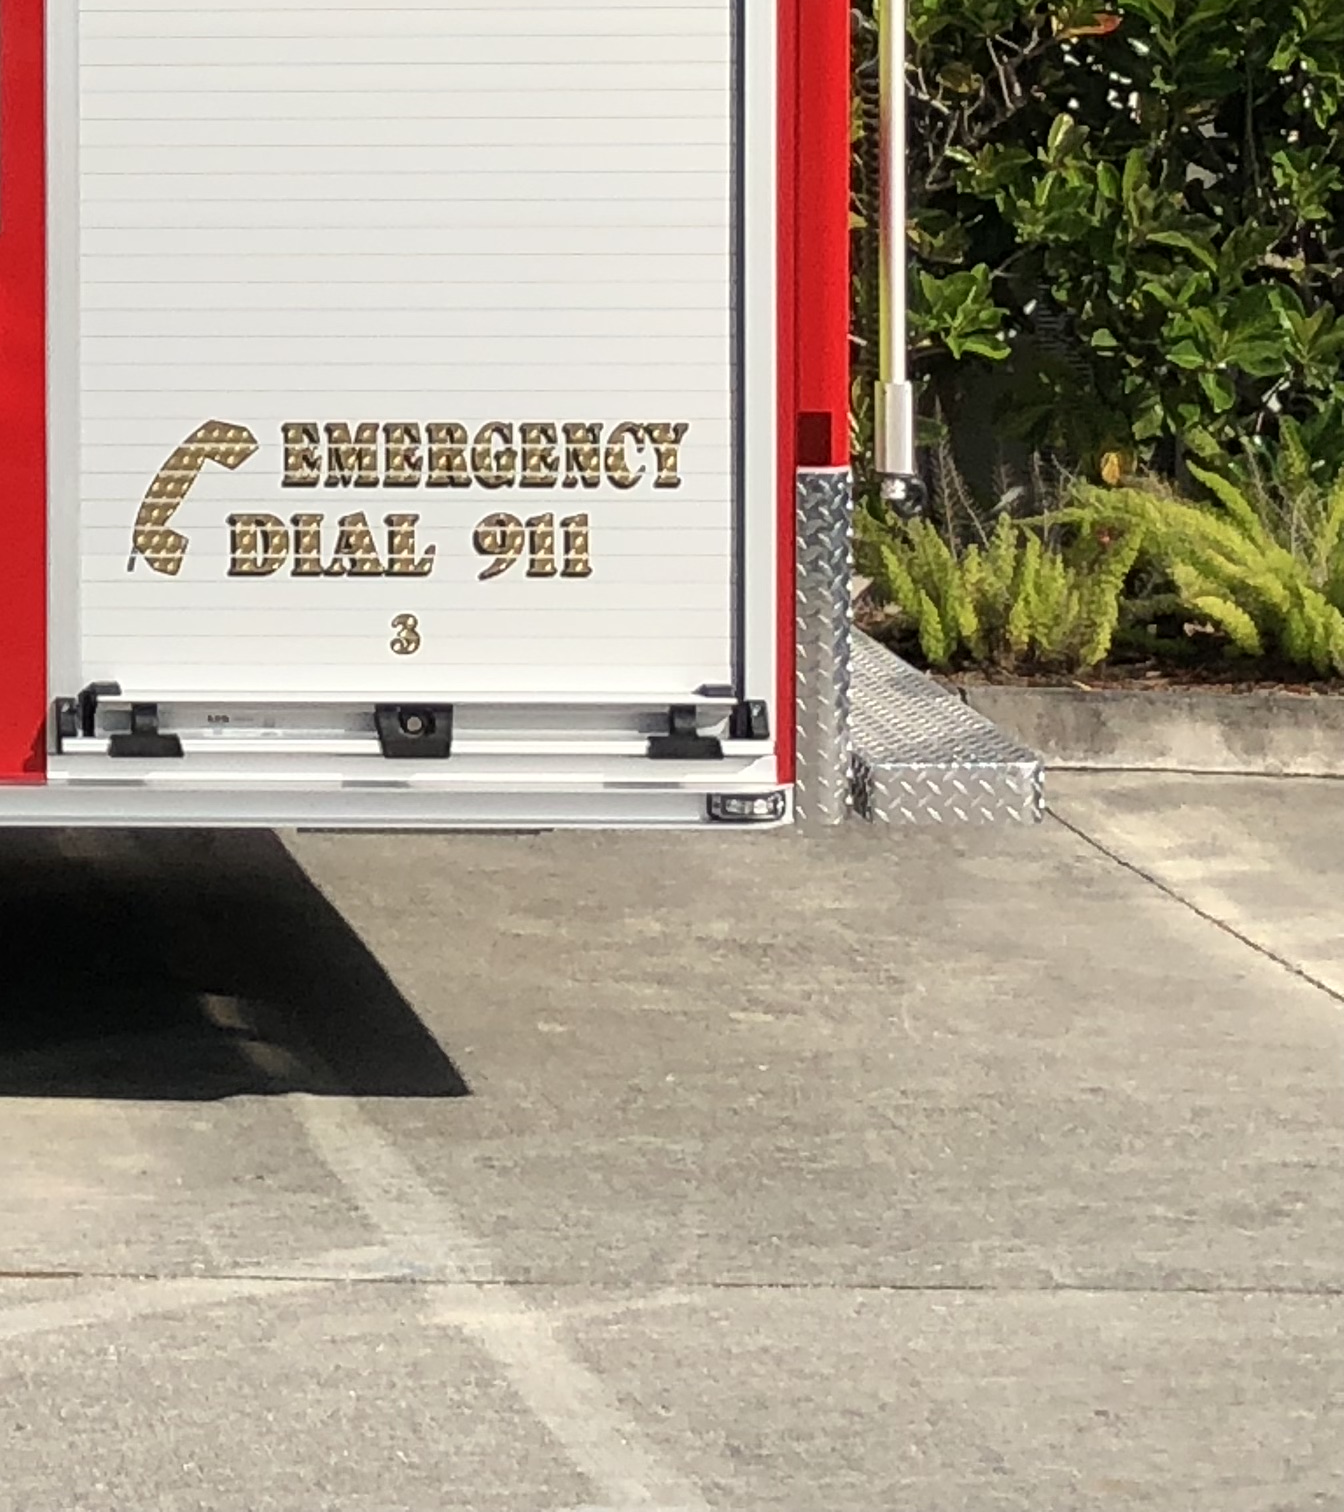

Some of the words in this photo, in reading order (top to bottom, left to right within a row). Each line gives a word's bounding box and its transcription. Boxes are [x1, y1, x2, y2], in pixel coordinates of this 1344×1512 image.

[280, 421, 690, 489] EMERGENCY
[226, 511, 437, 578] DIAL
[473, 512, 593, 581] 911
[389, 613, 422, 655] 3
